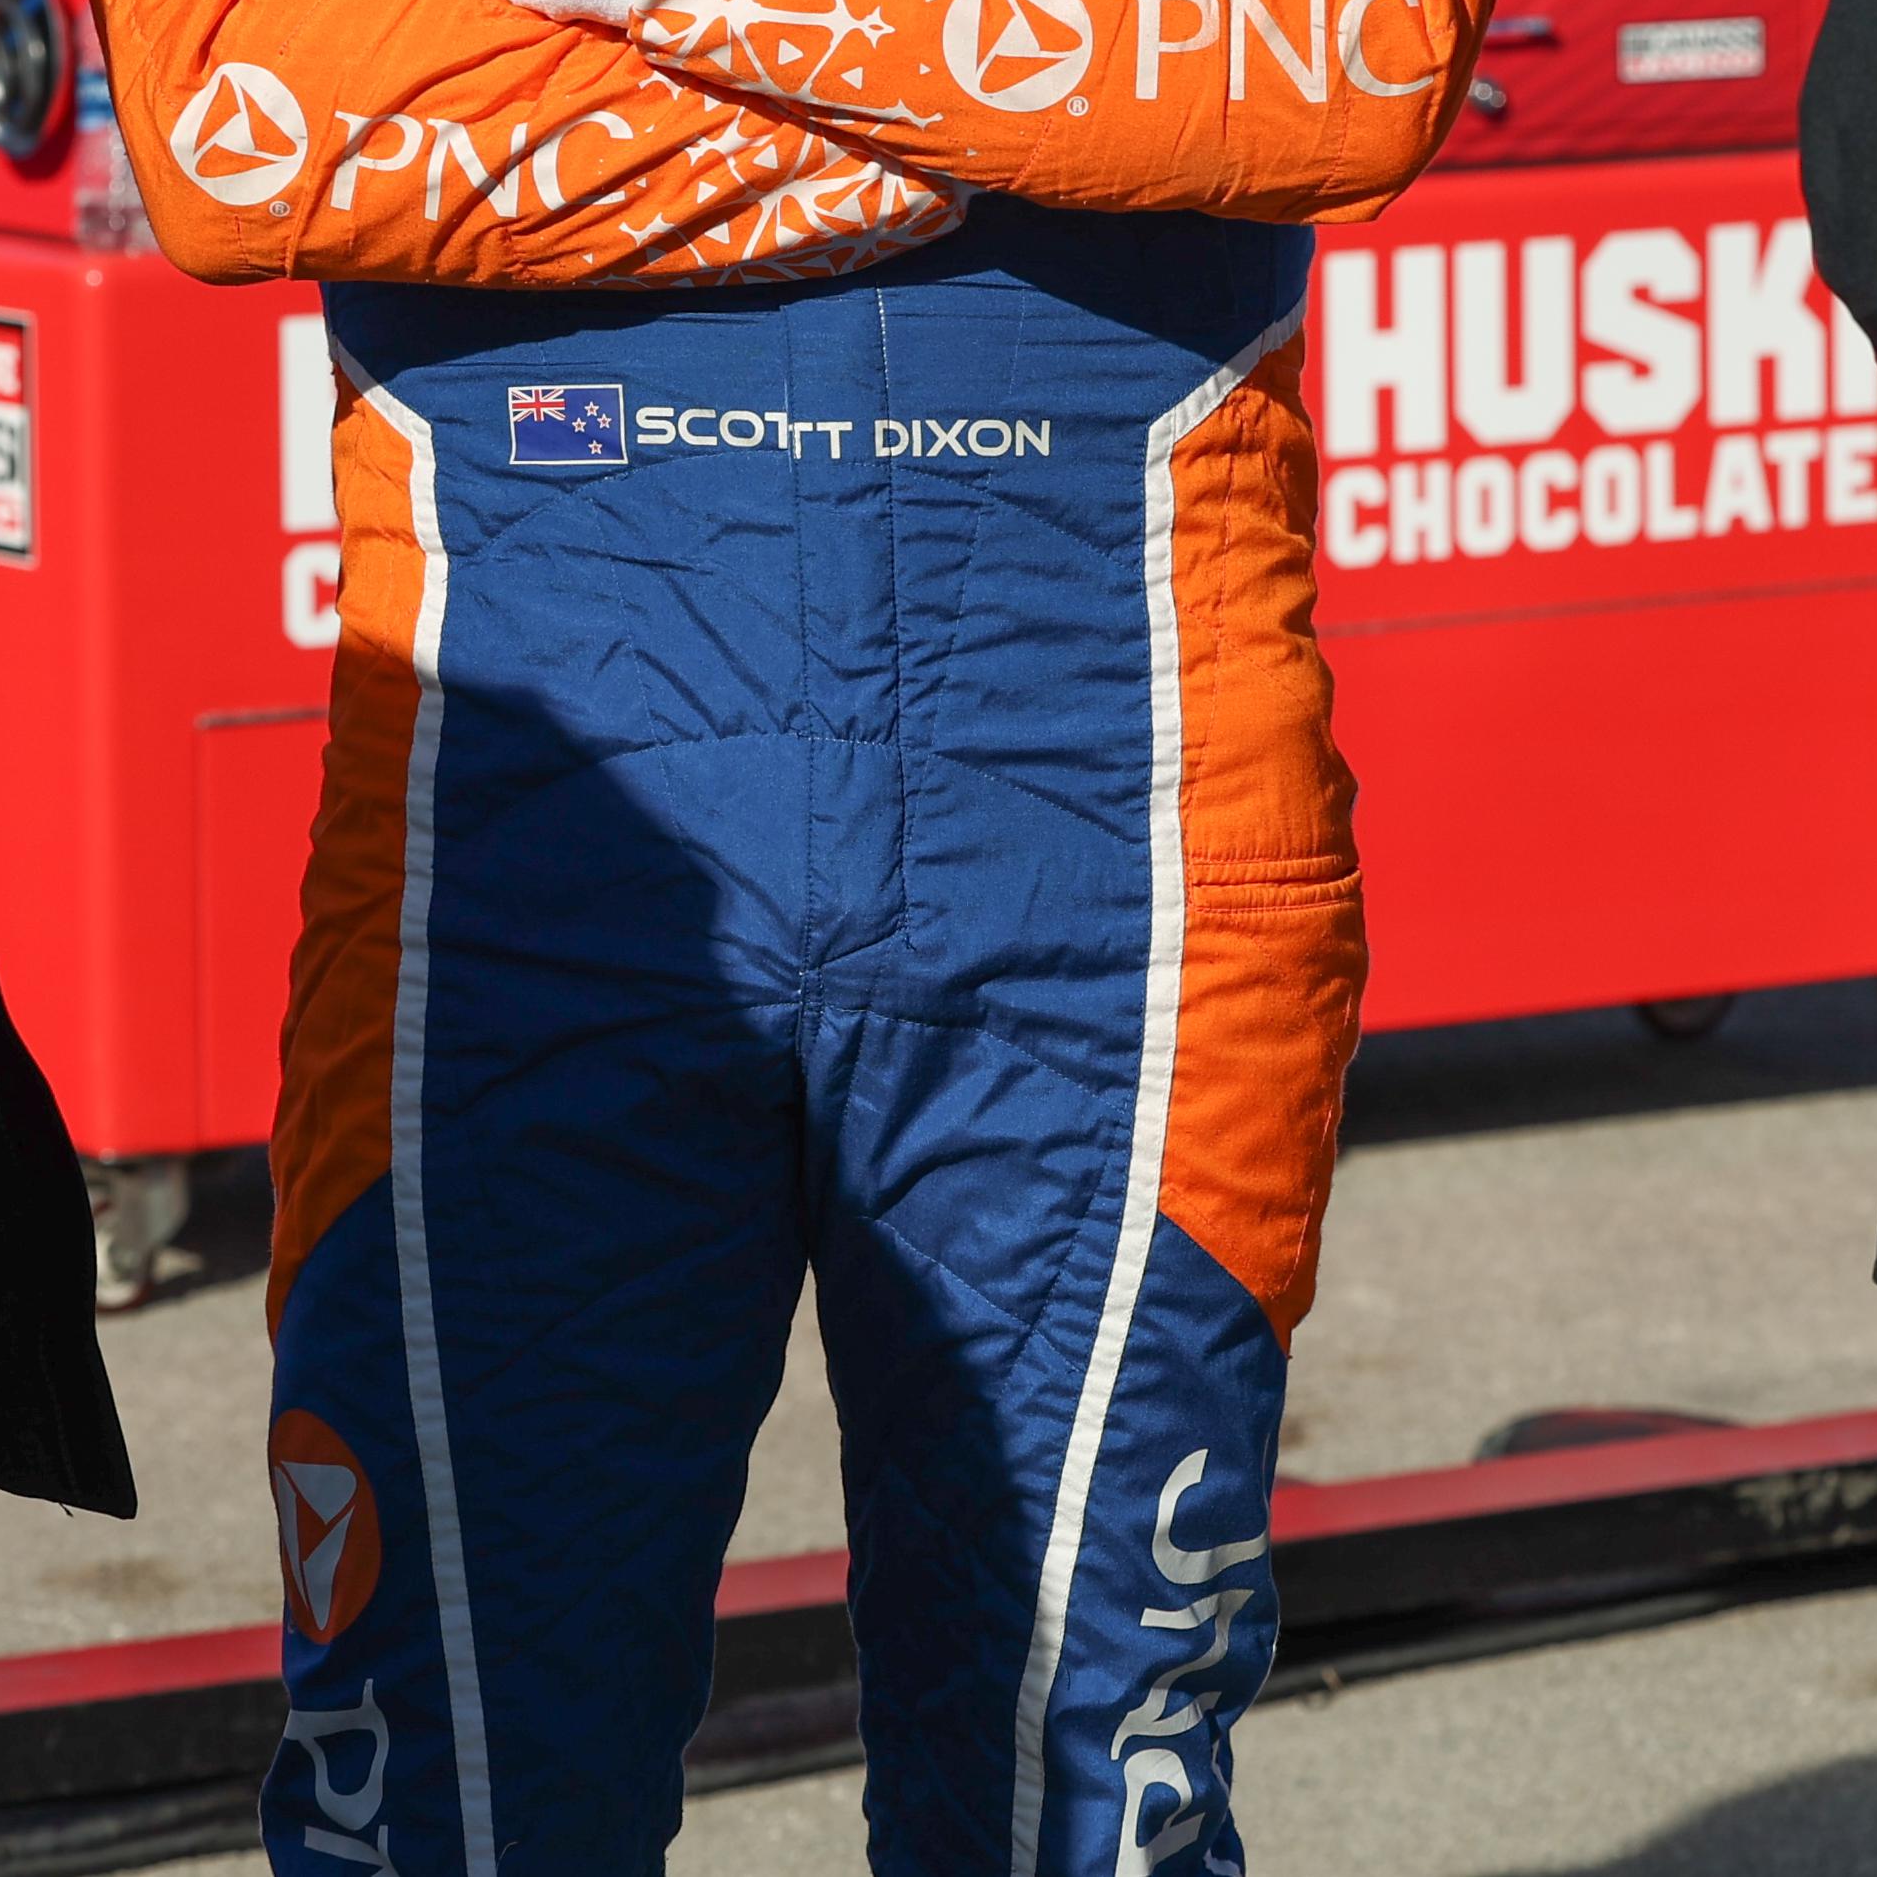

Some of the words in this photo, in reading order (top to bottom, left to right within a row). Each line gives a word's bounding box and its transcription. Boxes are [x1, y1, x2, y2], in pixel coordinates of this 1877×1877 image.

[330, 110, 634, 221] PNC
[635, 406, 853, 460] SCOTT
[874, 418, 1051, 459] DIXON
